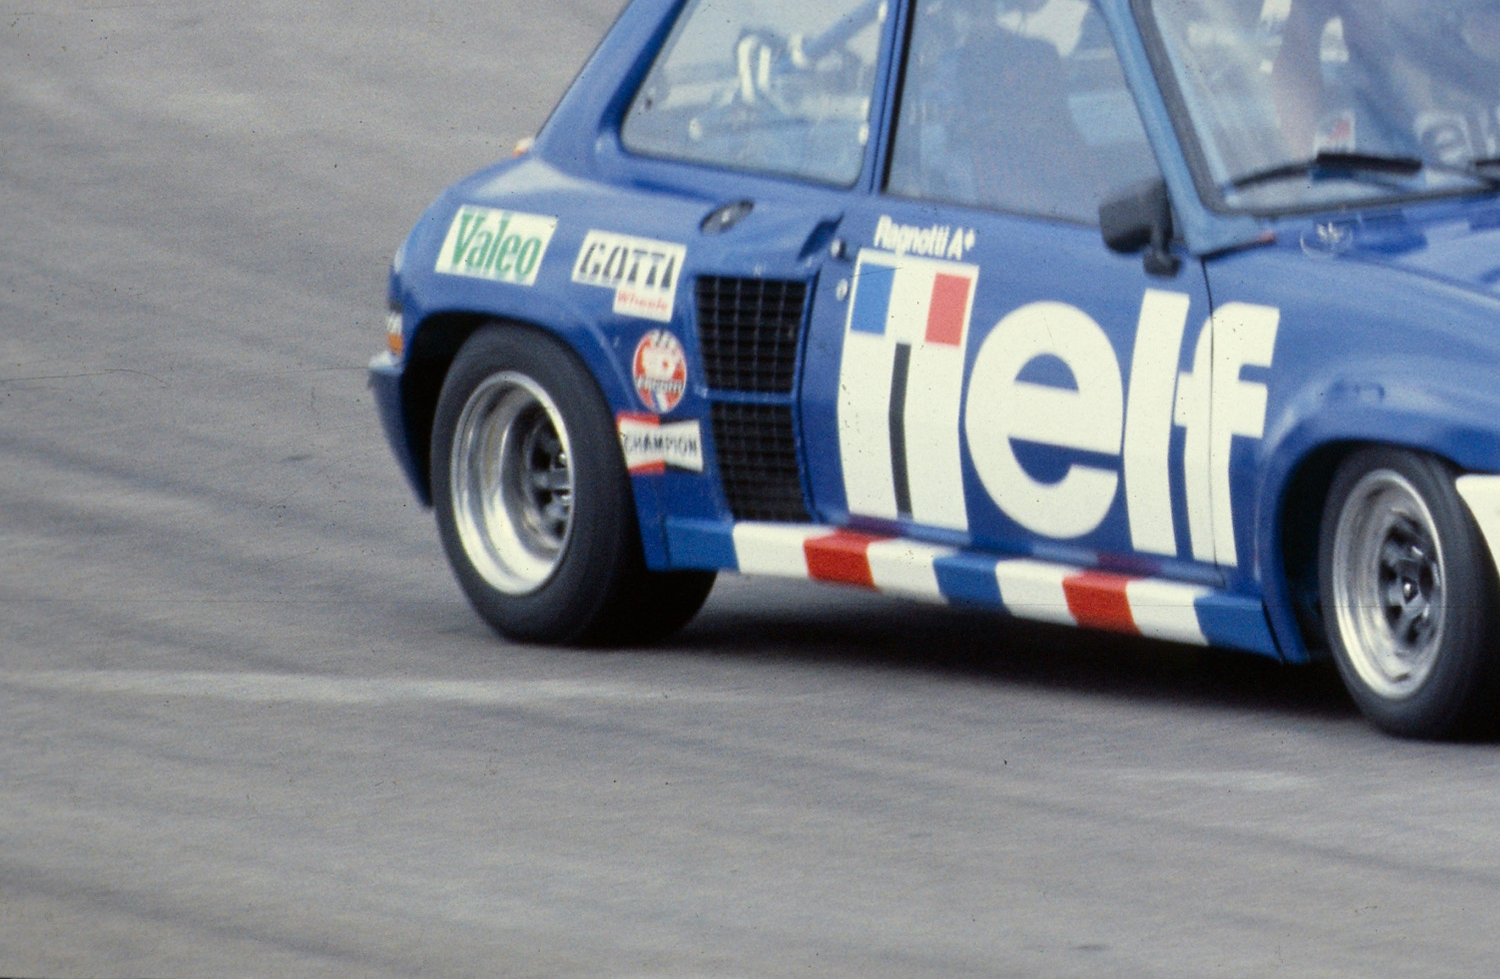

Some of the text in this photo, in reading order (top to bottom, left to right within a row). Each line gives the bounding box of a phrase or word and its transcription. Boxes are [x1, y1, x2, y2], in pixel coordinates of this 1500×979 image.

[452, 213, 542, 277] Valeo
[873, 214, 950, 260] Ragnotti
[579, 242, 676, 289] GOTTI
[623, 432, 698, 459] CHAMPION
[965, 288, 1280, 567] elf
